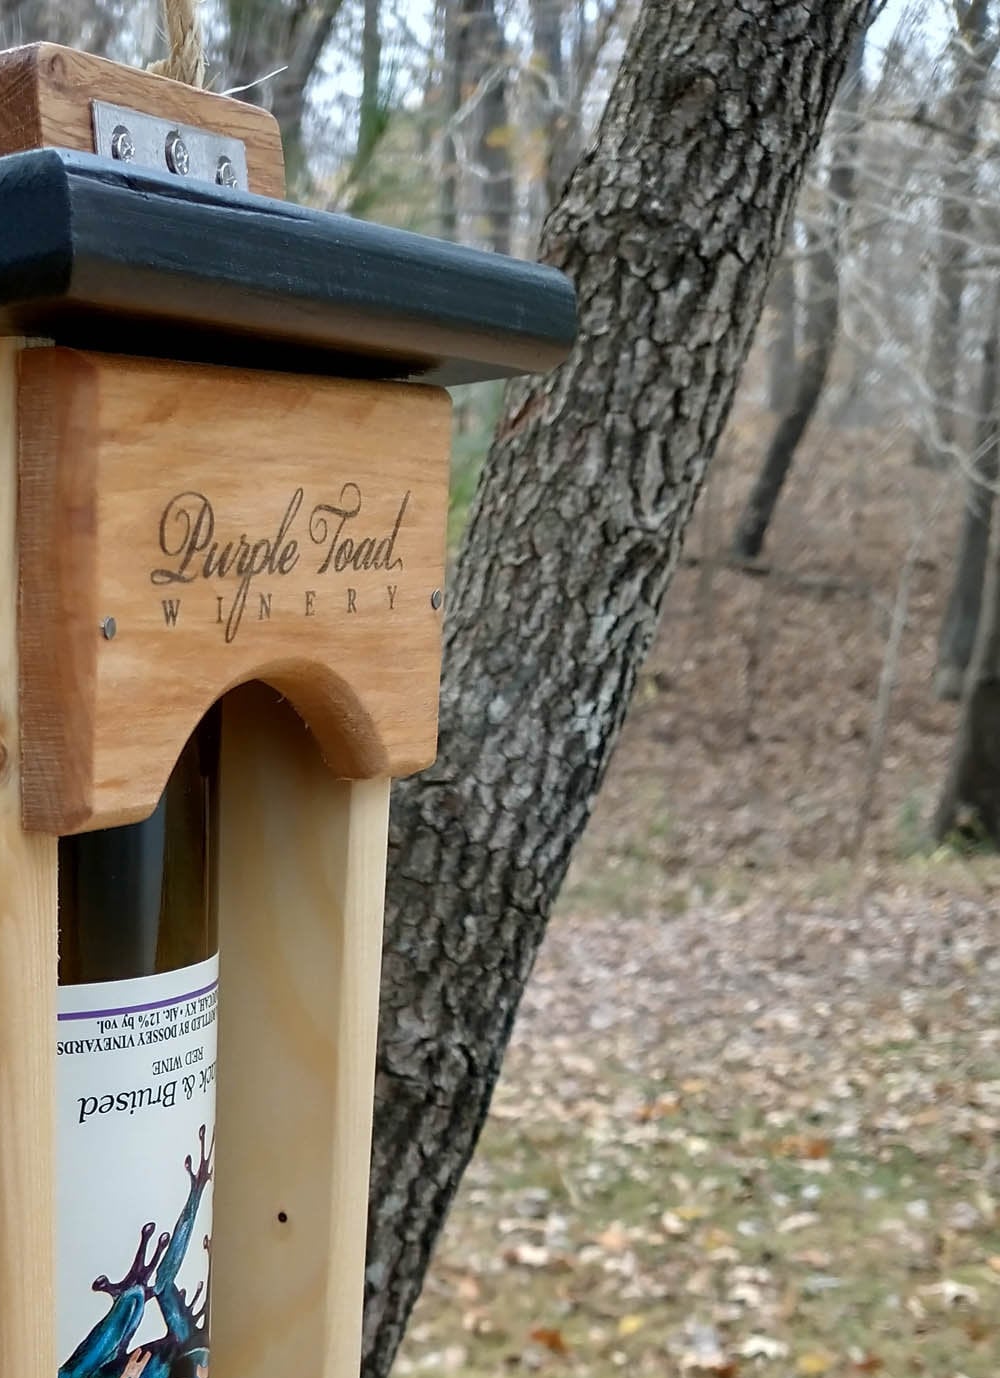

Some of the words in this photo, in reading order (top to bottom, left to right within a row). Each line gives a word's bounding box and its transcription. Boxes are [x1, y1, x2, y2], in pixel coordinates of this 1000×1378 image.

[151, 491, 303, 643] Purple
[309, 482, 411, 575] Toad
[162, 584, 398, 627] WINERY
[163, 1007, 179, 1022] Alc.
[185, 1001, 197, 1018] KY
[97, 1021, 118, 1034] vol.
[121, 1014, 134, 1030] by
[138, 1012, 160, 1029] 12%
[179, 1020, 190, 1036] BY
[57, 1033, 135, 1056] VINEYARDS
[137, 1024, 177, 1047] DOSSEY
[152, 1056, 182, 1076] WINE
[185, 1046, 204, 1066] RED
[182, 1074, 195, 1100] &
[78, 1080, 177, 1123] Bruised
